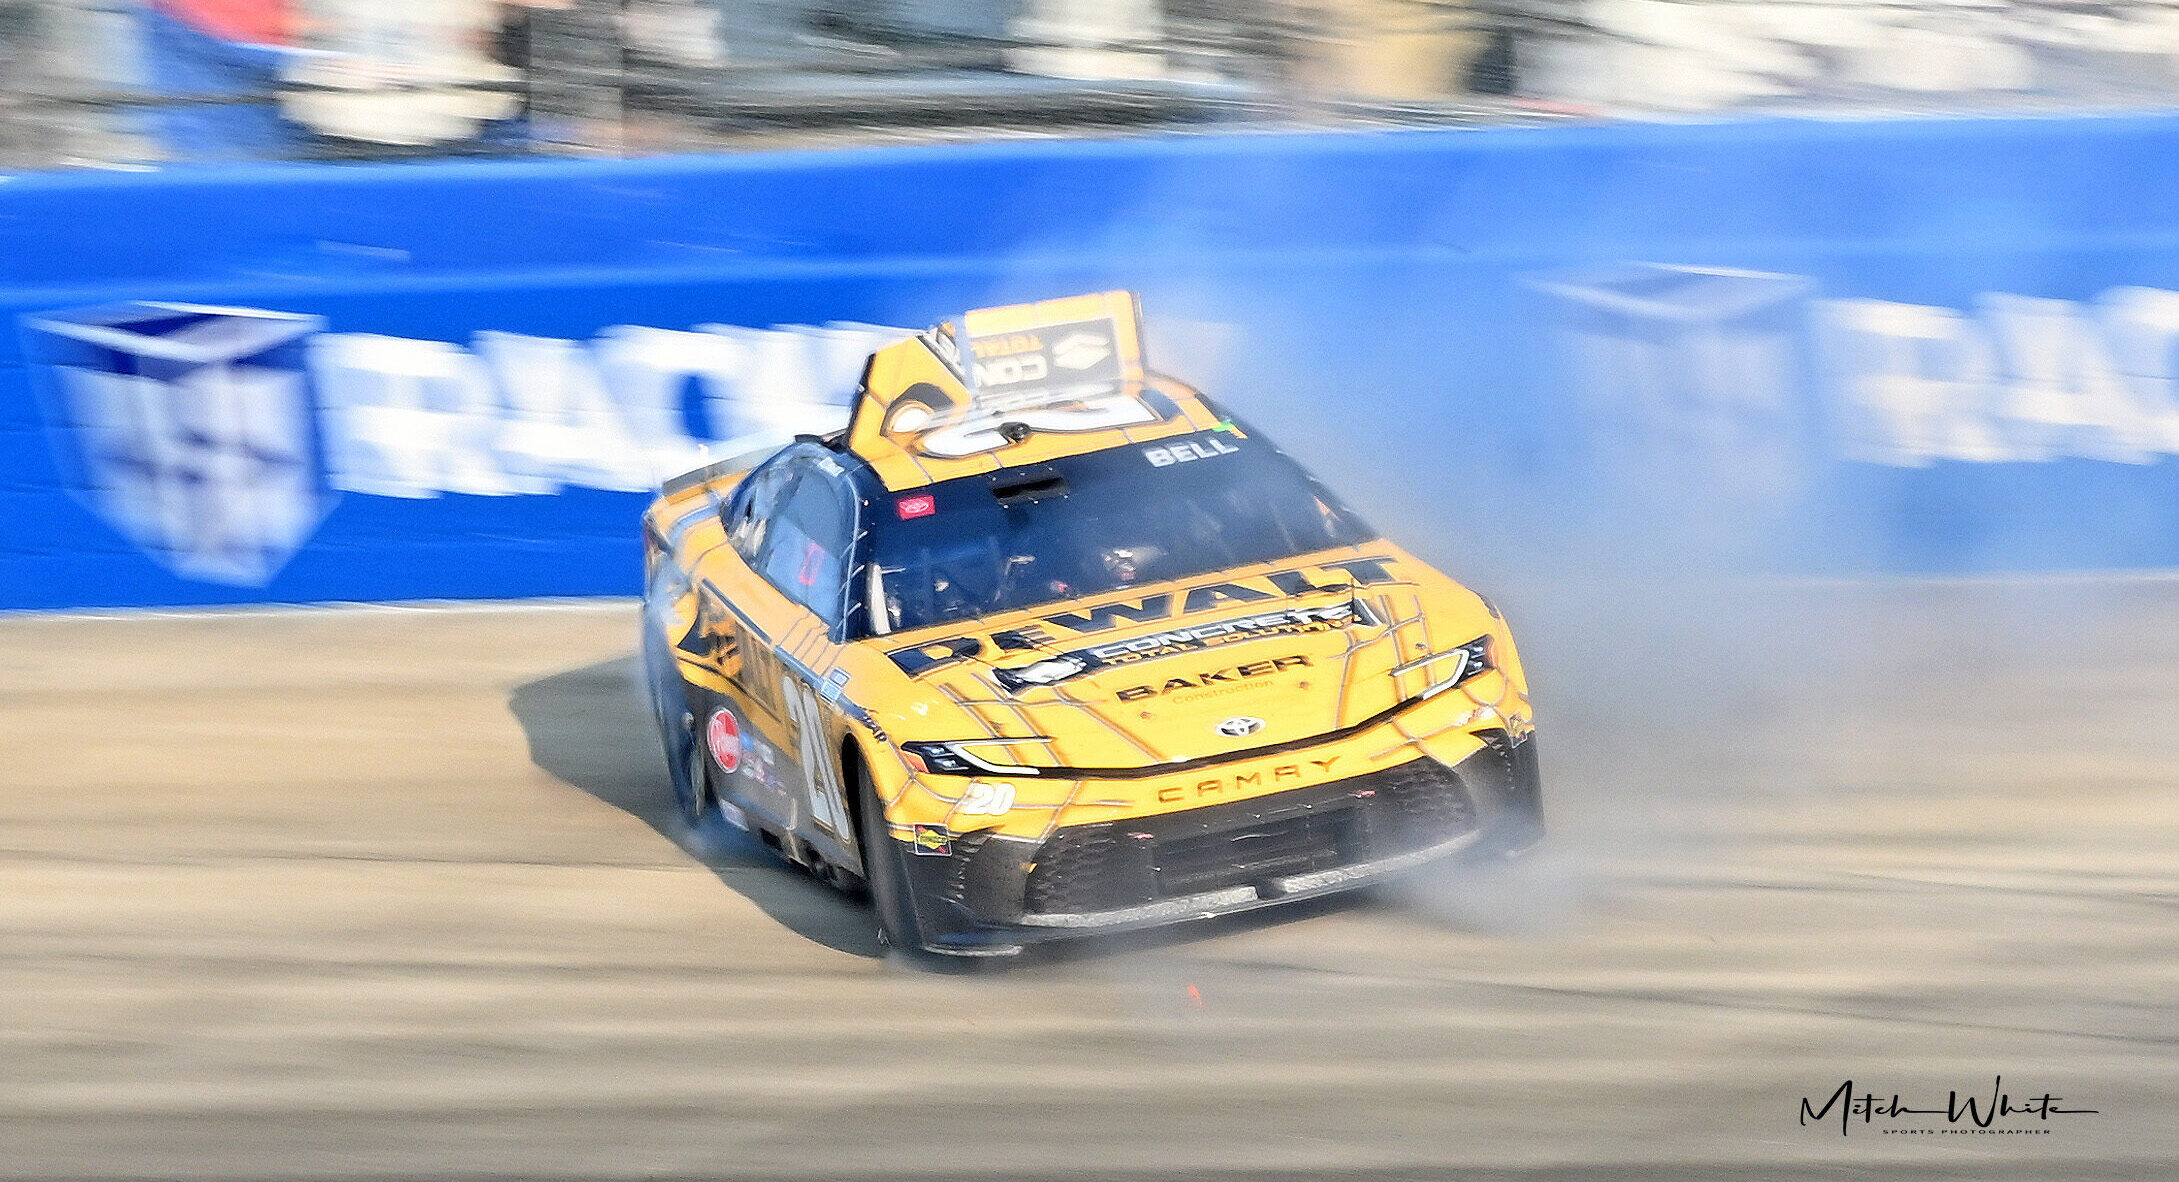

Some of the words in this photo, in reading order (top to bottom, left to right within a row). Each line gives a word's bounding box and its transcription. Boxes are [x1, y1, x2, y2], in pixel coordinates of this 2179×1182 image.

[1144, 436, 1240, 468] BELL
[884, 556, 1398, 680] DEWALT
[1092, 603, 1352, 659] CONCRETE
[1099, 642, 1199, 666] TOTAL
[1115, 654, 1314, 705] BAKER
[1172, 678, 1274, 706] Construction
[958, 782, 1017, 816] 20
[1158, 755, 1342, 804] CAMRY
